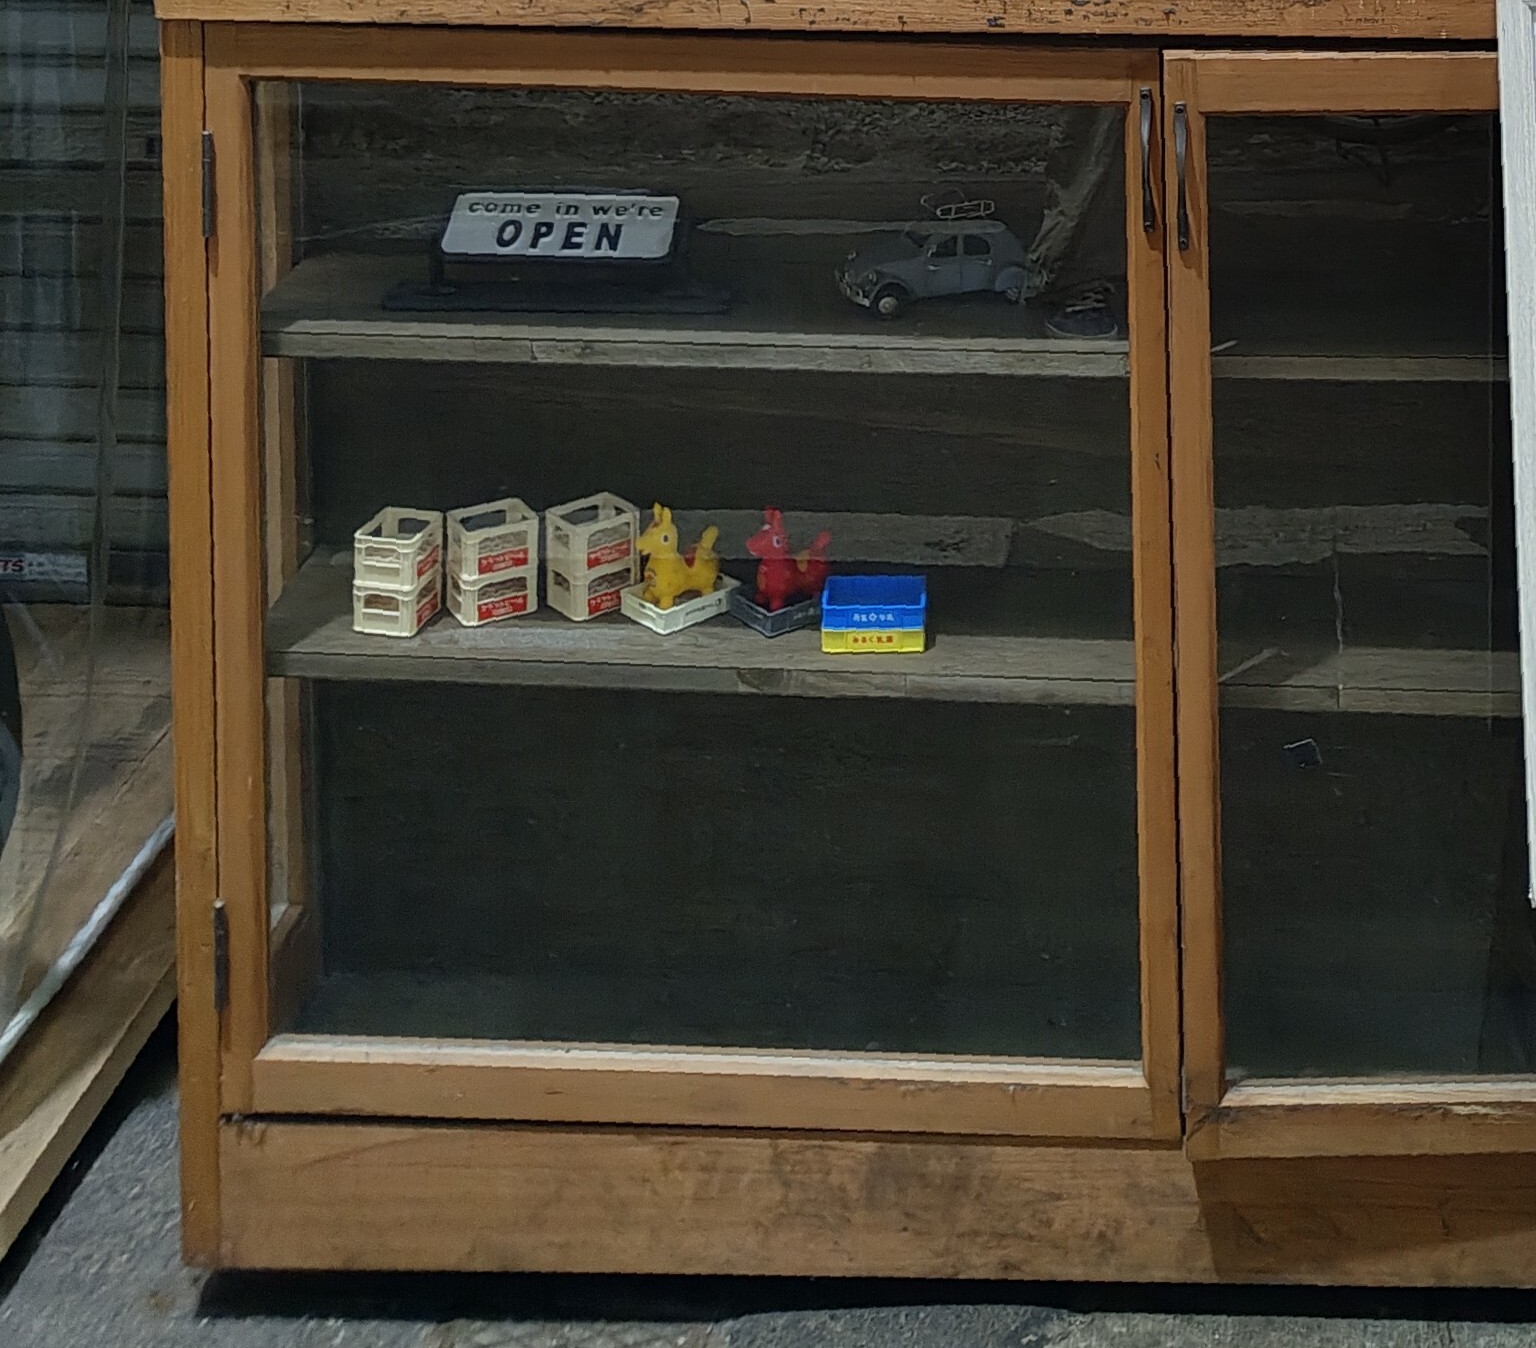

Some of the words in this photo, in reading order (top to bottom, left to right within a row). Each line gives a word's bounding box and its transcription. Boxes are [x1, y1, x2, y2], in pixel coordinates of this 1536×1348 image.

[467, 201, 542, 216] come
[555, 202, 580, 216] in
[591, 202, 664, 218] we're
[496, 219, 624, 253] OPEN
